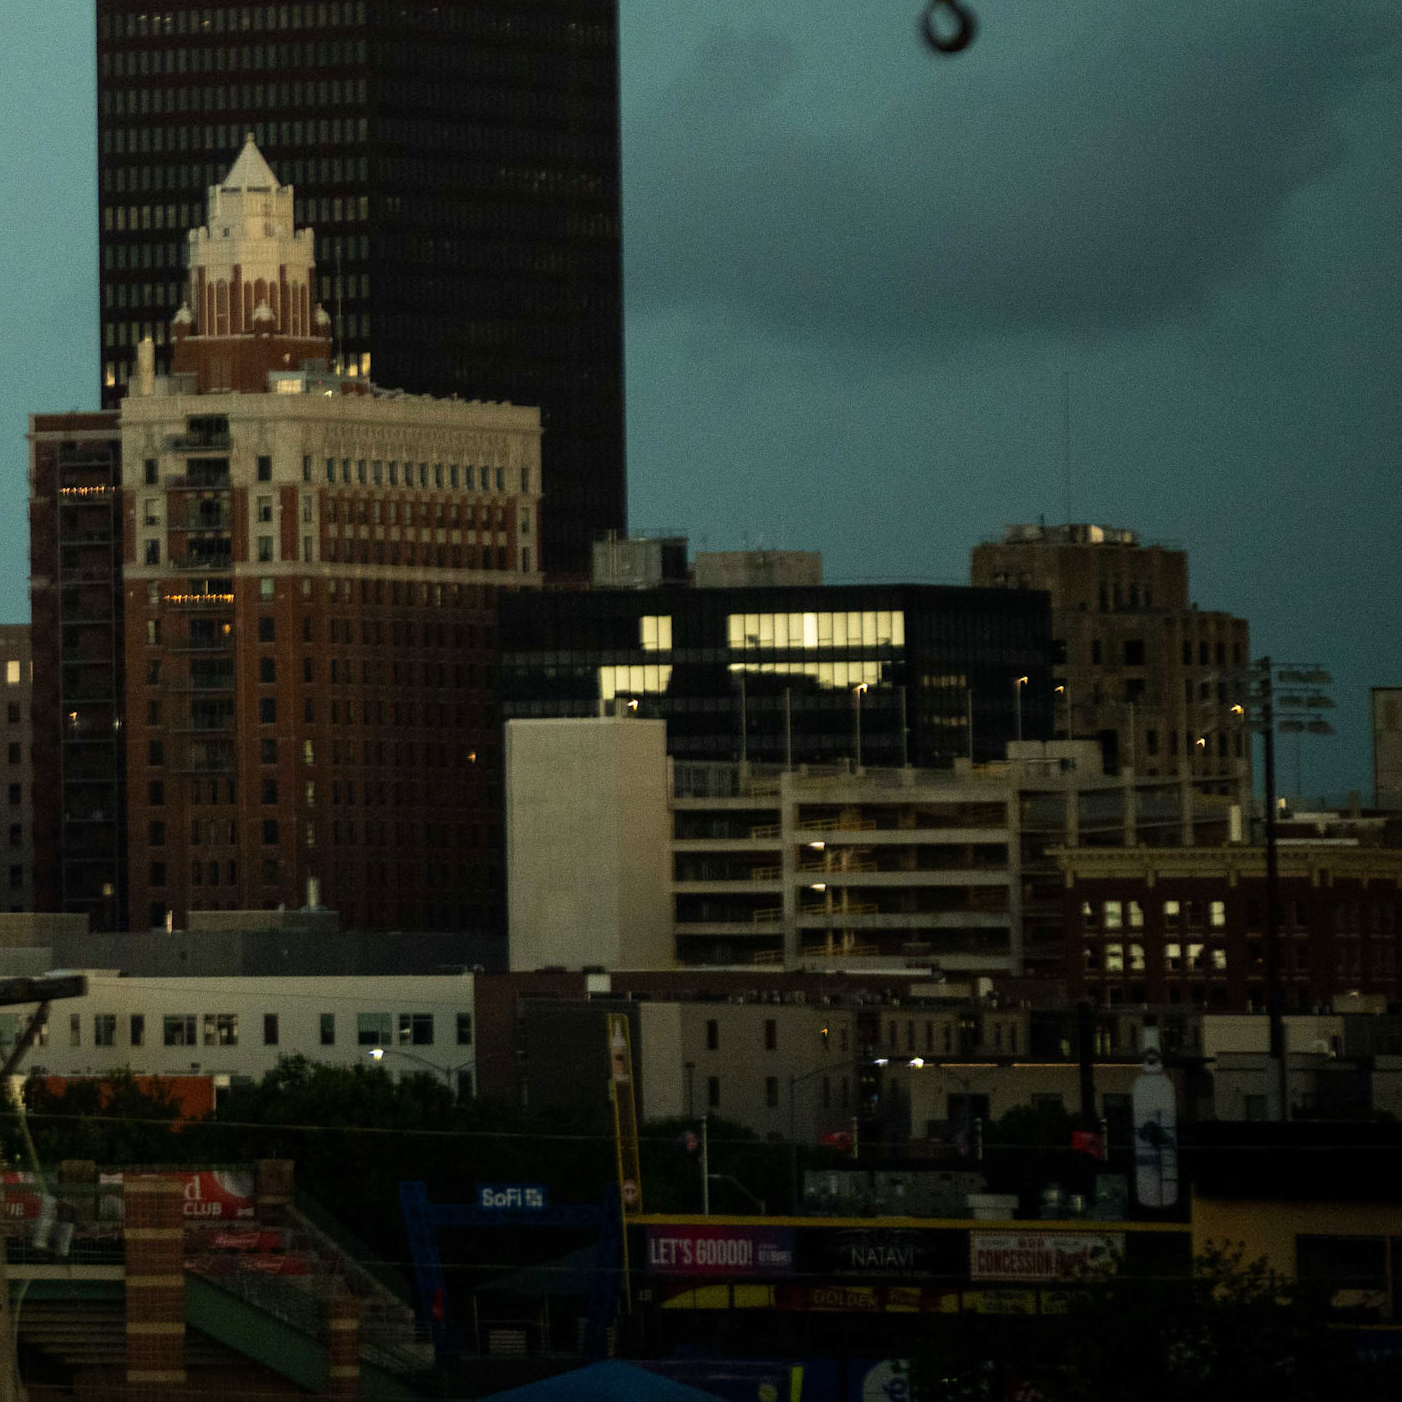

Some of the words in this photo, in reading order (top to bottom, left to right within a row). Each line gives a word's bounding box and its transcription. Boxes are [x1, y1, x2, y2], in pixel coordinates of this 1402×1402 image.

[481, 1187, 523, 1208] SoFi
[183, 1201, 223, 1217] CLUB
[650, 1237, 693, 1265] LET'S
[696, 1238, 754, 1266] GOOOO!
